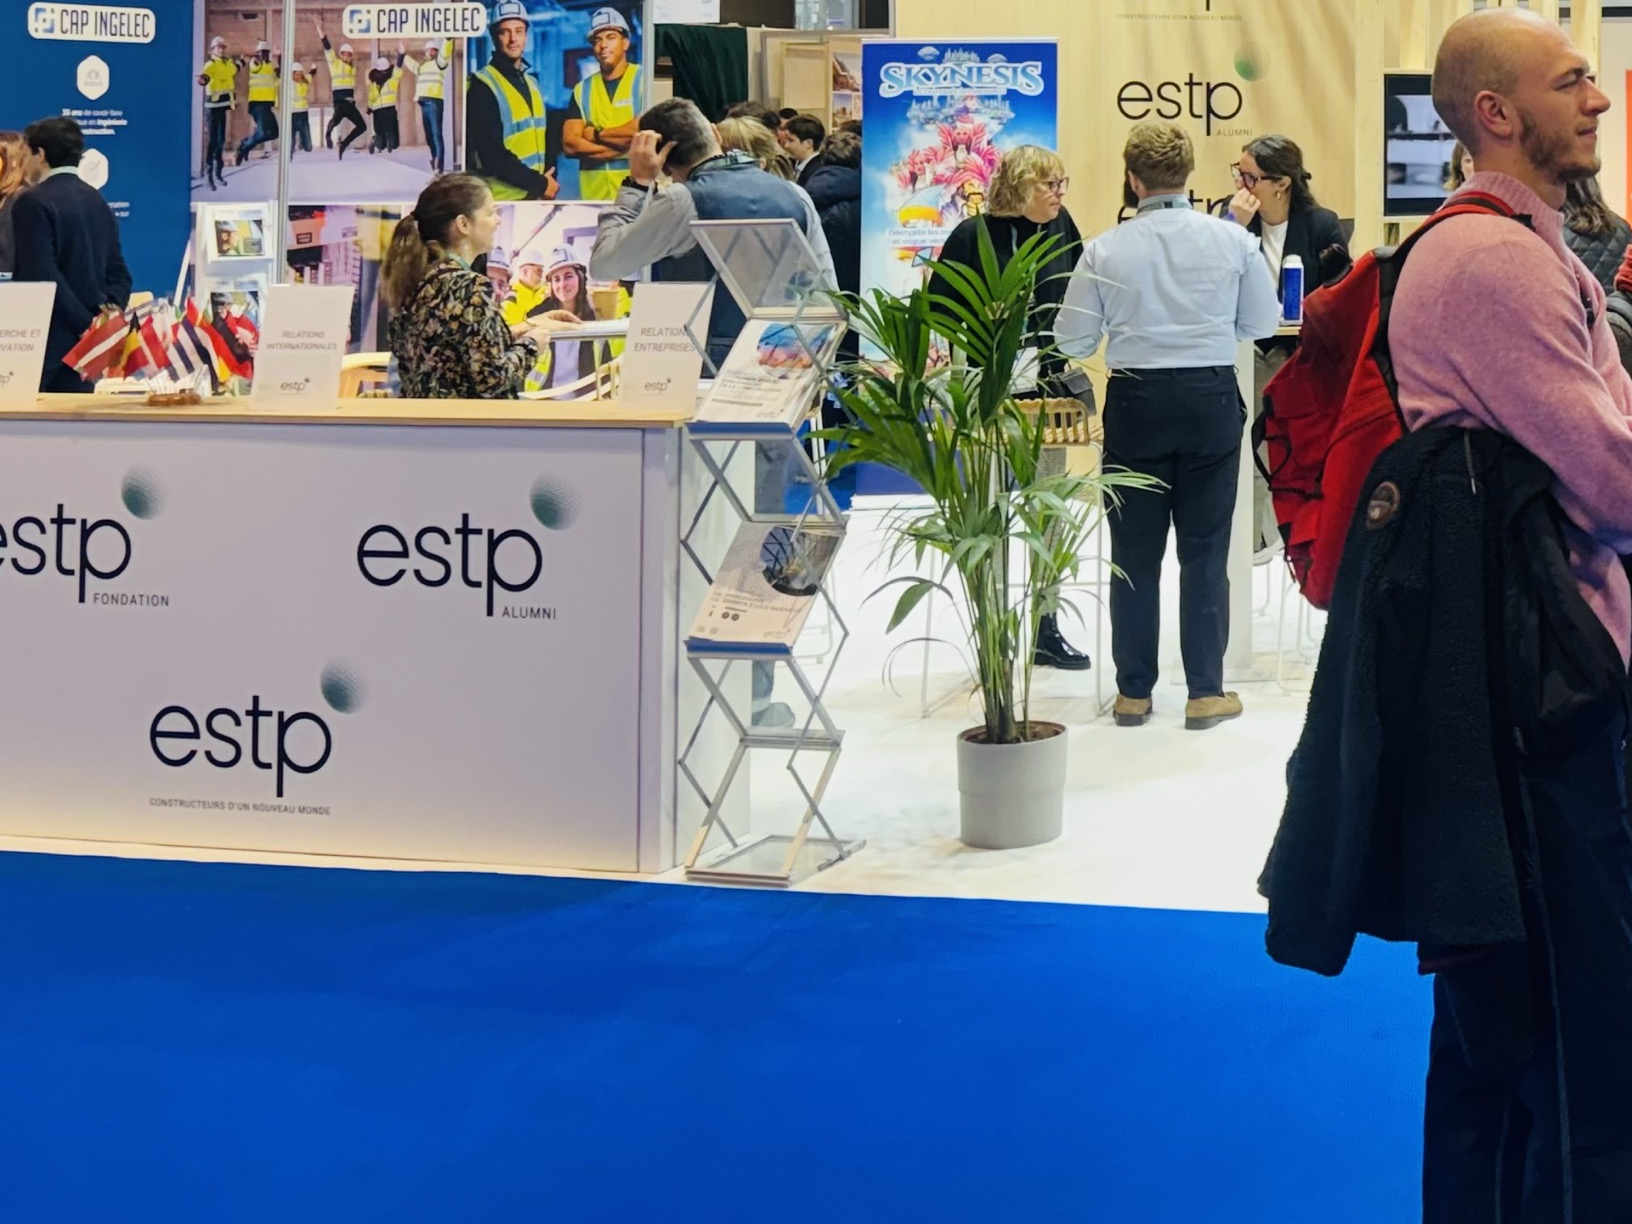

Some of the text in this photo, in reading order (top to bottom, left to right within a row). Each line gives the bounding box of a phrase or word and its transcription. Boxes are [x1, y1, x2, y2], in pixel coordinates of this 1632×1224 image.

[60, 9, 151, 38] CAP INGELEC
[377, 7, 481, 33] CAP INGELEC
[880, 62, 1044, 98] SKYNESIS
[1116, 72, 1243, 137] estp
[1216, 129, 1253, 137] ALUMNI
[282, 330, 326, 339] RELATIONS
[640, 327, 688, 337] RELATION
[266, 342, 337, 351] INTERNATIONALES
[634, 342, 696, 353] ENTREPRISES
[280, 380, 306, 393] estp
[644, 379, 668, 394] estp
[0, 503, 131, 604] stp
[357, 513, 543, 617] estp
[93, 592, 170, 607] FONDATION
[501, 606, 557, 620] ALUMNI
[150, 695, 332, 798] estp
[149, 797, 331, 816] CONSTRUCTEURS D'UN NOUVEAU MONDE
